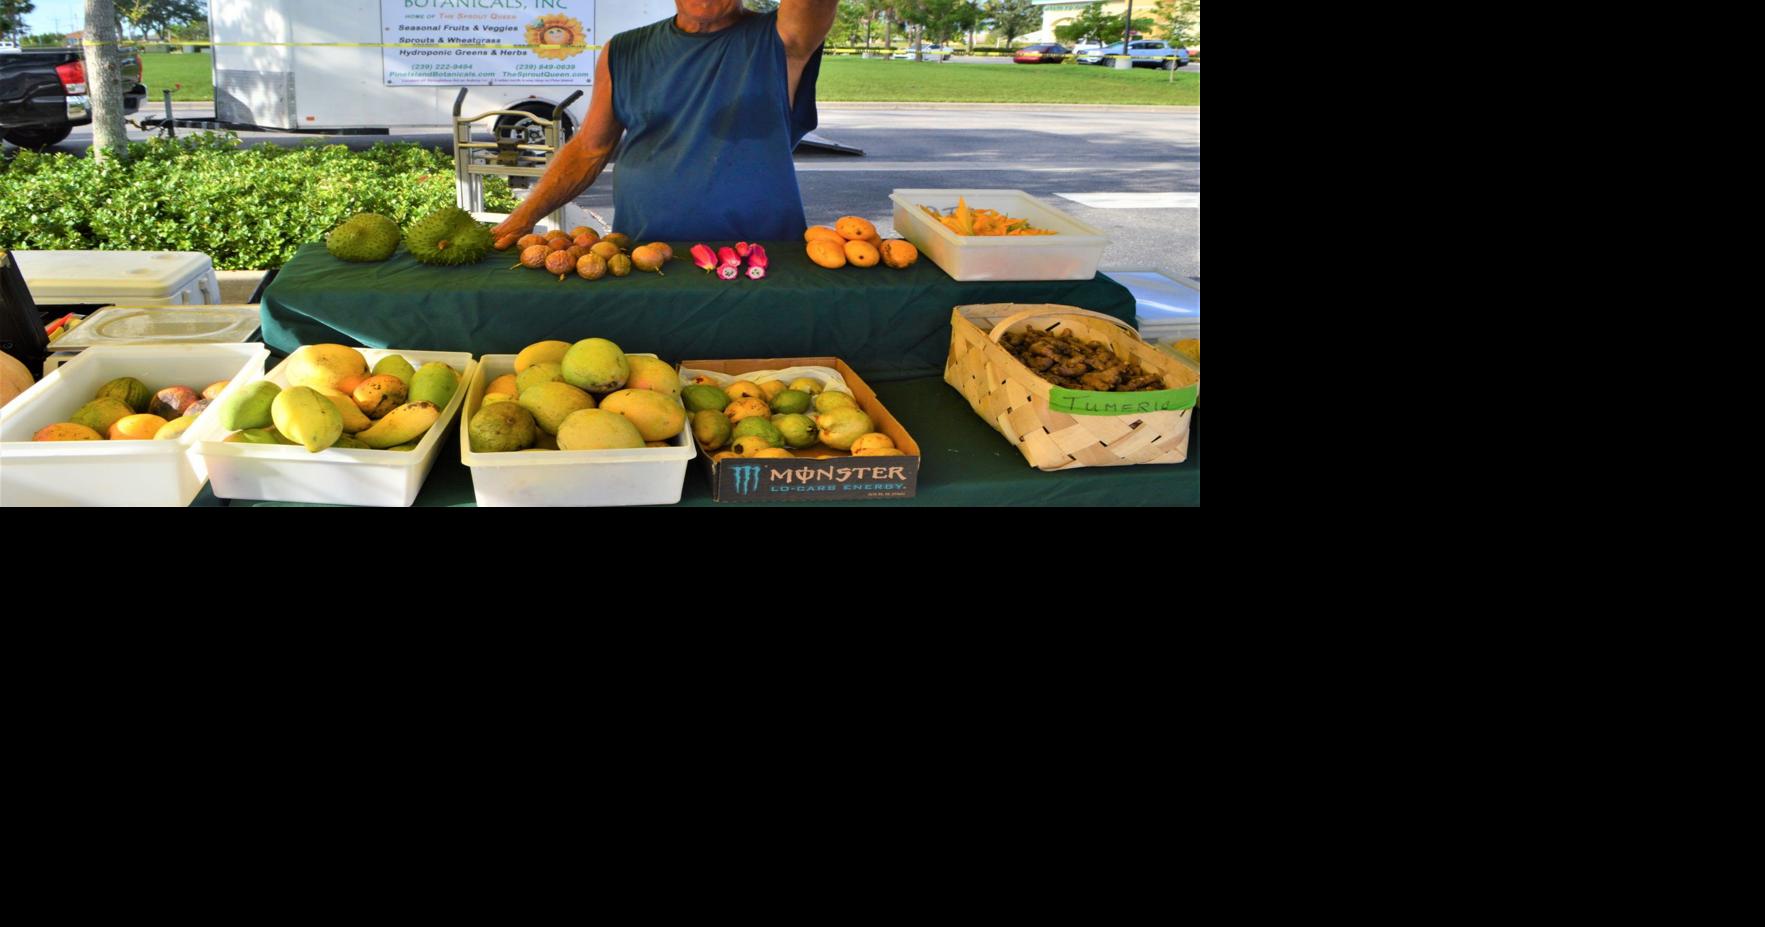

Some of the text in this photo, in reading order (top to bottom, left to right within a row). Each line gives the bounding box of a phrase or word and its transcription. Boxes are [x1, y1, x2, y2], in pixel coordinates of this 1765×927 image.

[404, 0, 567, 9] BOTANICALS, INC
[483, 25, 518, 33] Veggies
[399, 37, 435, 45] Sprouts
[447, 37, 501, 45] Wheatgrass
[399, 49, 452, 57] Hydroponic
[770, 466, 907, 484] MONSTER
[771, 484, 836, 492] LO-CARB
